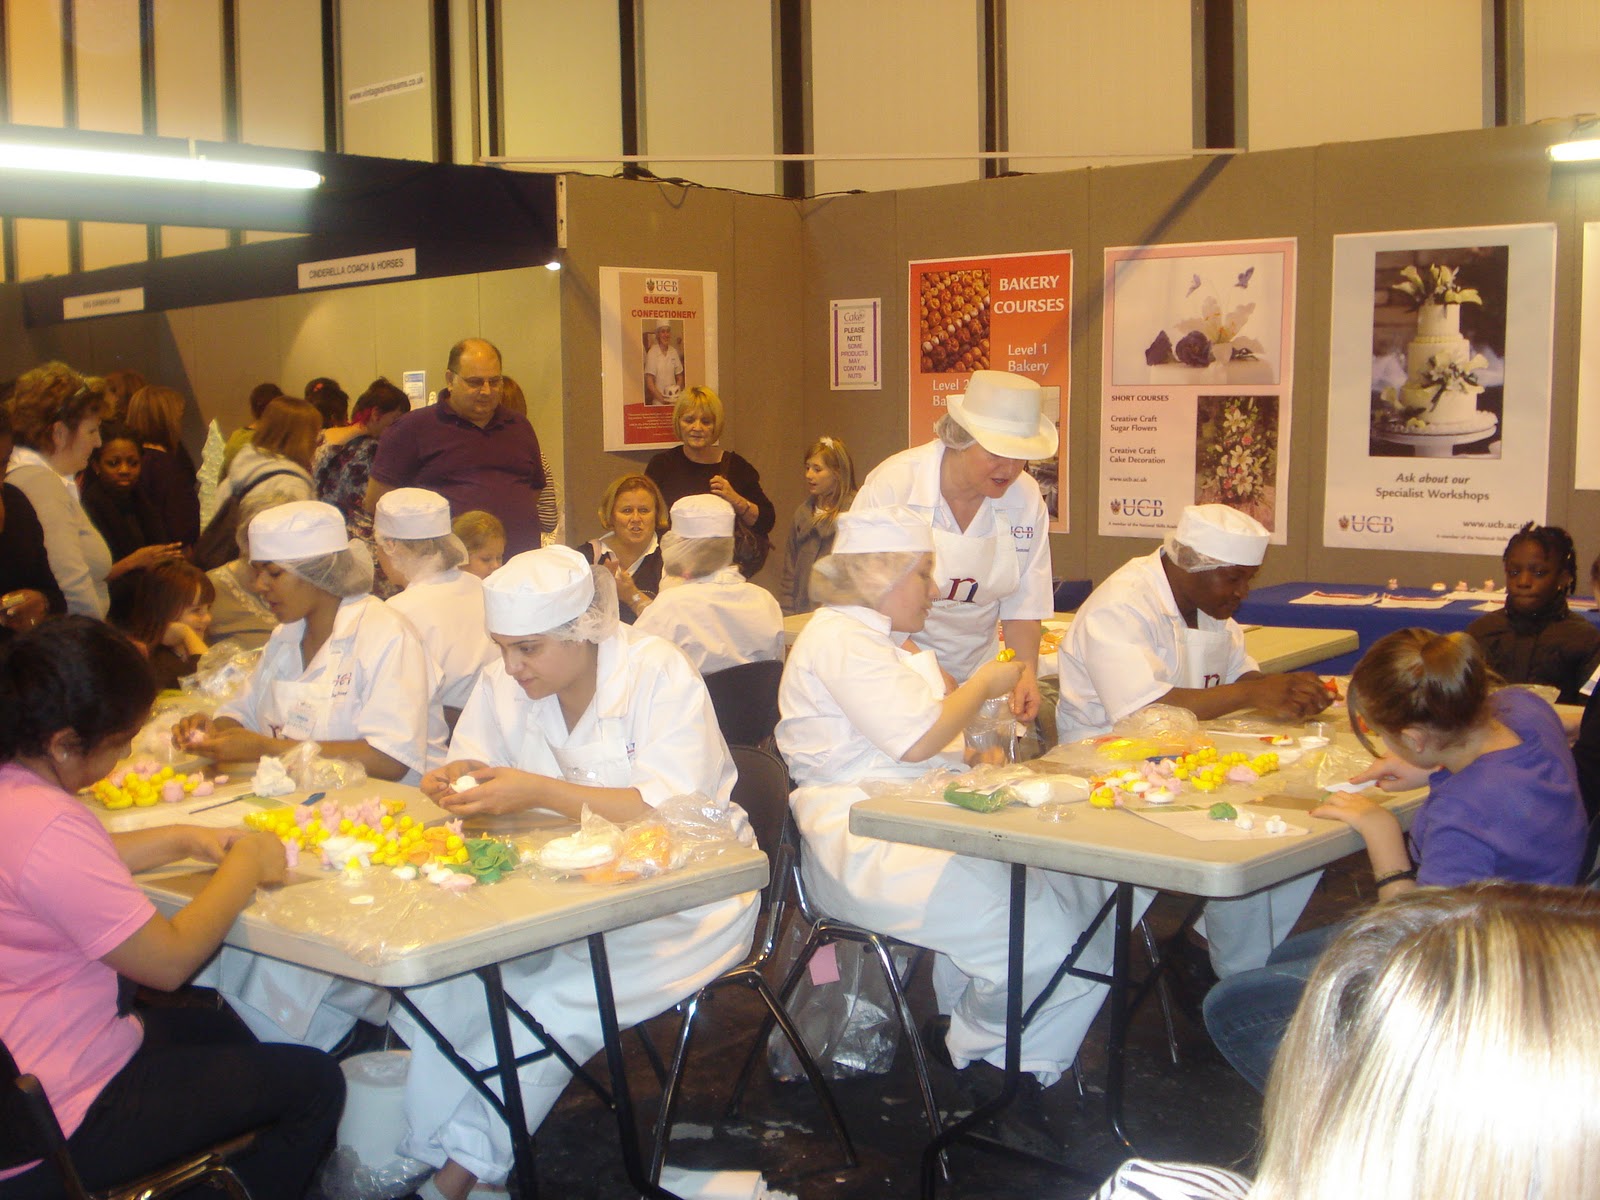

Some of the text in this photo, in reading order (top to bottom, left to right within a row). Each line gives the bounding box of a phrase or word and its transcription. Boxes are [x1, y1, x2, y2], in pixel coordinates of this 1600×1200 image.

[308, 258, 404, 279] CINDERELLA COACH & HORSES
[656, 280, 678, 293] UCB
[999, 275, 1060, 292] BAKERY
[643, 295, 683, 305] BAKERY &
[993, 298, 1065, 314] COURSES
[631, 309, 697, 319] CONFECTIONERY
[1008, 342, 1048, 356] Level 1
[1008, 359, 1049, 375] Bakery
[932, 379, 959, 391] Level
[1110, 424, 1158, 433] Sugar Flowers
[1109, 446, 1156, 455] Creative Craft
[1127, 456, 1166, 464] Decoration
[1395, 473, 1471, 484] Ask about our
[1375, 487, 1490, 503] Specialist Workshops
[1122, 498, 1164, 518] UCB
[1351, 515, 1395, 534] UCB
